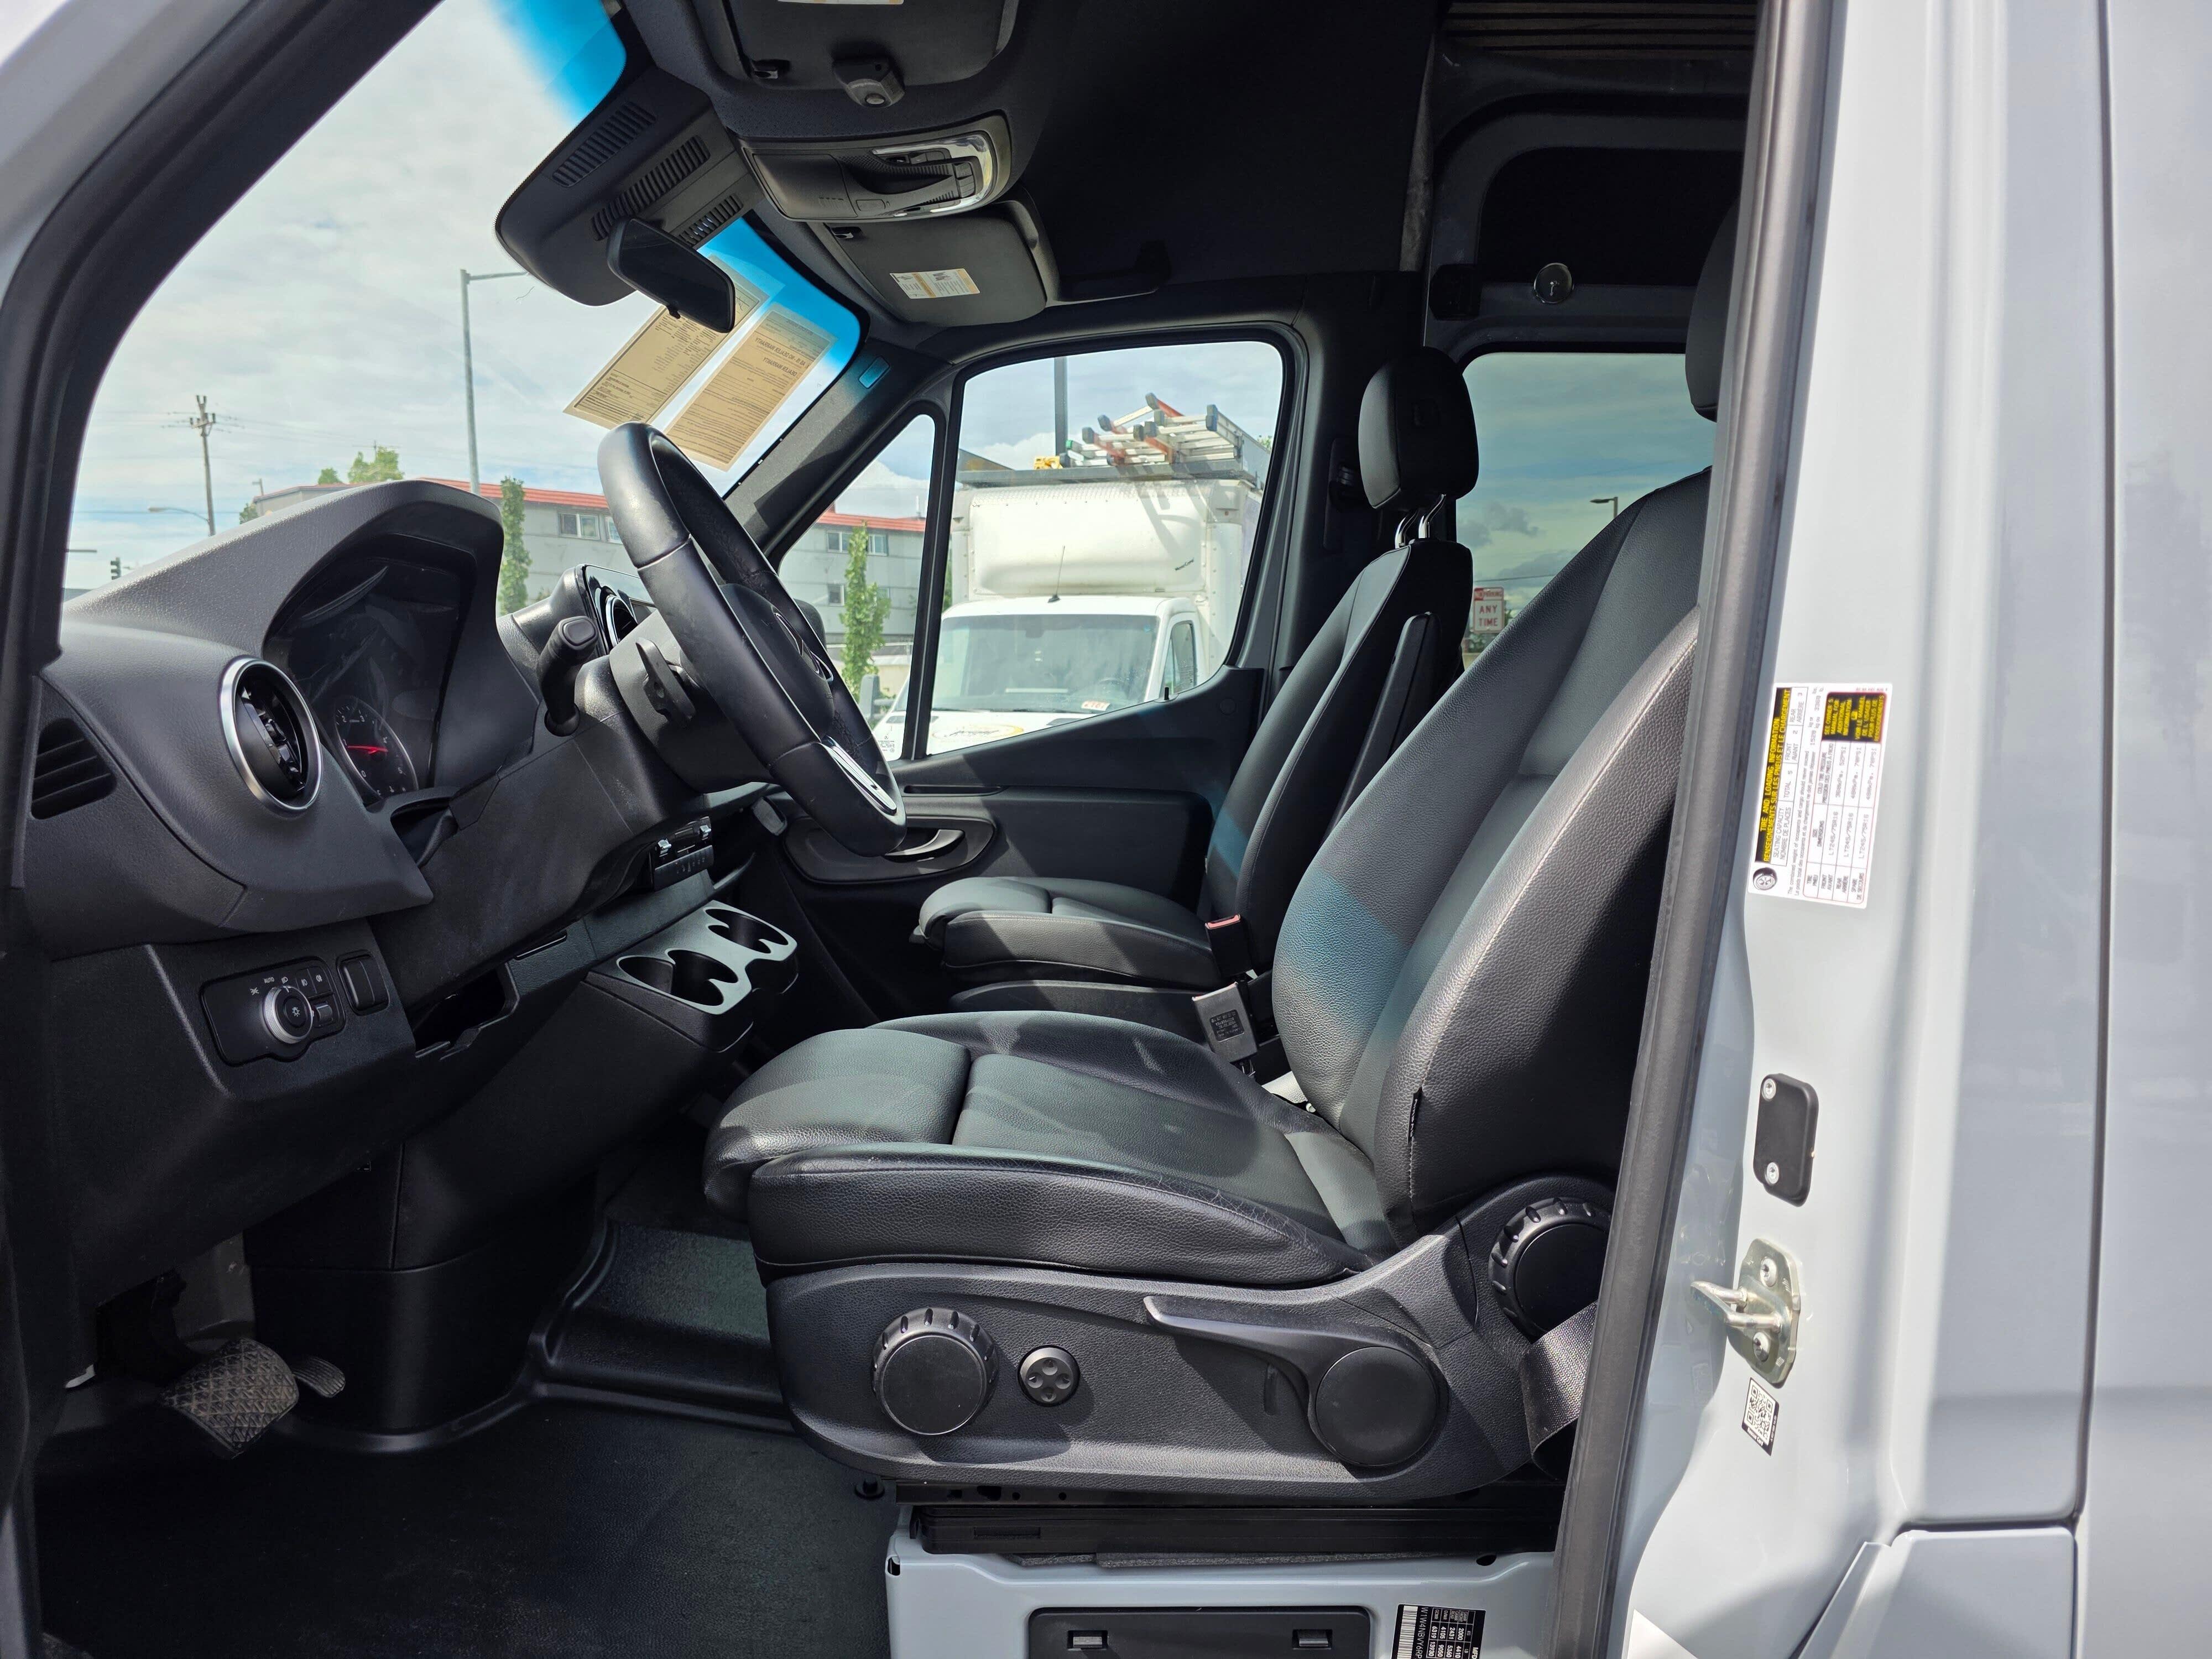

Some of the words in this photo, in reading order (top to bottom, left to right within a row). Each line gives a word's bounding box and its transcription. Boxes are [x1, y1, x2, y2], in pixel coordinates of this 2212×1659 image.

[1479, 604, 1498, 614] ANY
[1479, 618, 1498, 627] TIME
[1778, 689, 1790, 733] CHARGEMENT
[1768, 717, 1780, 763] INFORMATION
[1777, 734, 1785, 742] LE
[1776, 744, 1783, 753] ET
[1773, 753, 1782, 775] PNEUS
[1764, 765, 1774, 795] LOADING
[1783, 780, 1791, 798] TOTAL
[1762, 799, 1770, 813] AND
[1760, 816, 1768, 832] TIRE
[1776, 807, 1784, 834] CAPACITY
[1763, 804, 1777, 862] RENSEIGNEMENTS
